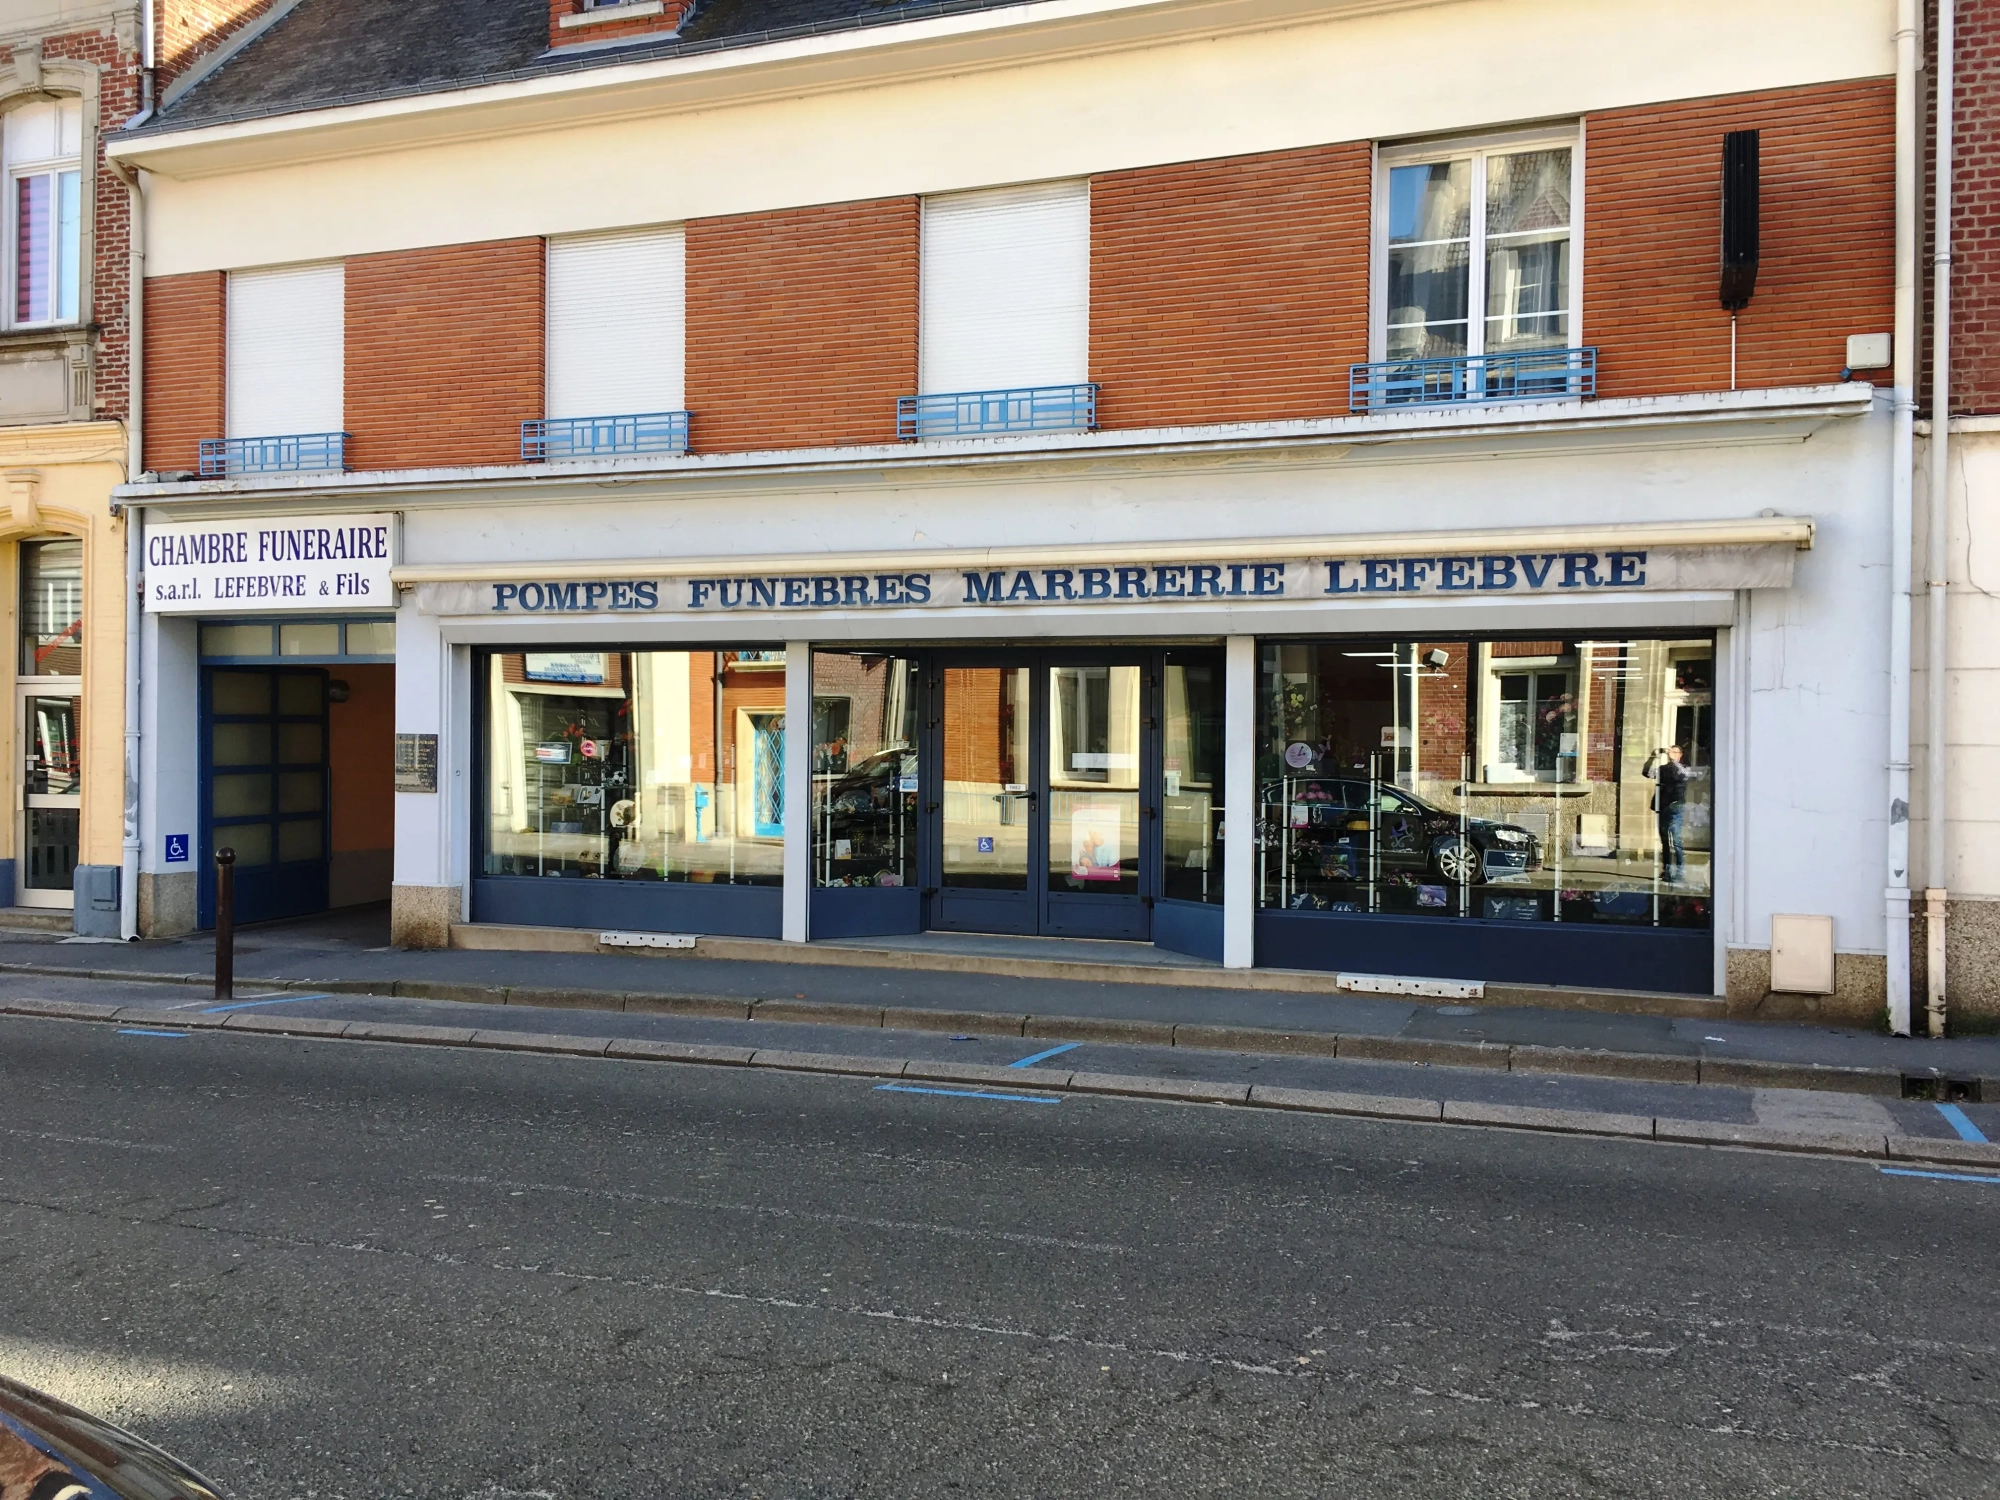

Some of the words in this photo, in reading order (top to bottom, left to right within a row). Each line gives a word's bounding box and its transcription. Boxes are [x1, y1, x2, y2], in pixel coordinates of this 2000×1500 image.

[149, 532, 248, 566] CHAMBRE
[258, 526, 388, 562] FUNERAIRE
[155, 577, 202, 600] s.a.r.l.
[214, 574, 306, 599] LEFEBVRE
[319, 580, 330, 596] &
[336, 572, 370, 596] Fils
[492, 580, 659, 611] POMPES
[687, 573, 932, 609] FUNEBRES
[962, 563, 1285, 603] MARBRERIE
[1324, 551, 1648, 593] LEFEBVRE
